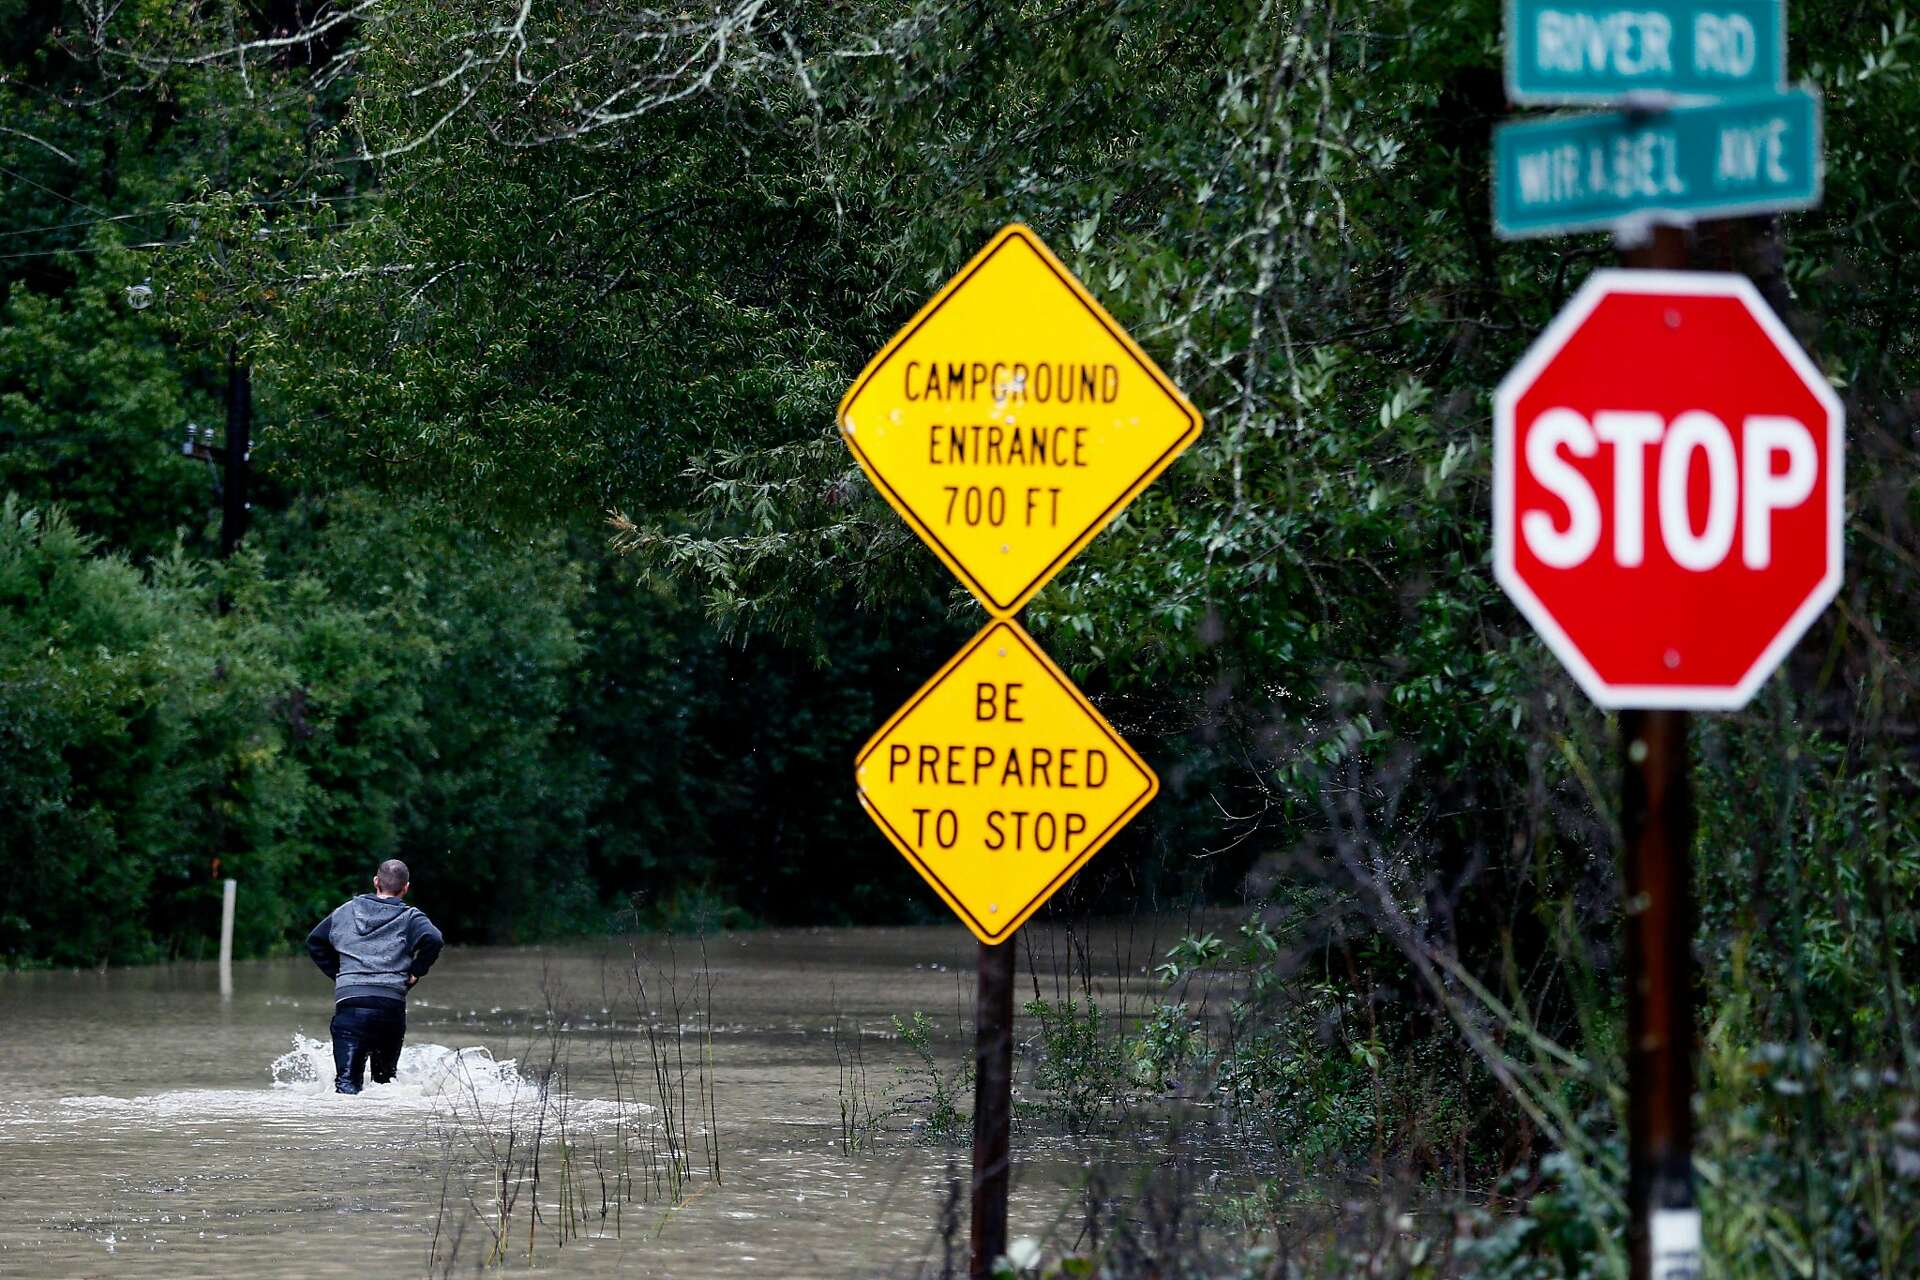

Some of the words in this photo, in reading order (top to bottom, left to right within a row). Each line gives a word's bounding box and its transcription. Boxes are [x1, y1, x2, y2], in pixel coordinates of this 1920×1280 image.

[1536, 9, 1672, 75] RIVER
[1694, 12, 1755, 77] RD
[1718, 118, 1788, 183] AVE
[905, 362, 1119, 404] CAMPGROUND
[929, 425, 1089, 467] ENTRANCE
[943, 486, 1006, 527] 700
[1025, 488, 1063, 527] FT
[1521, 406, 1818, 572] STOP
[975, 682, 1024, 722] BE
[889, 744, 1108, 789] PREPARED
[912, 808, 958, 849] TO
[984, 810, 1087, 853] STOP
